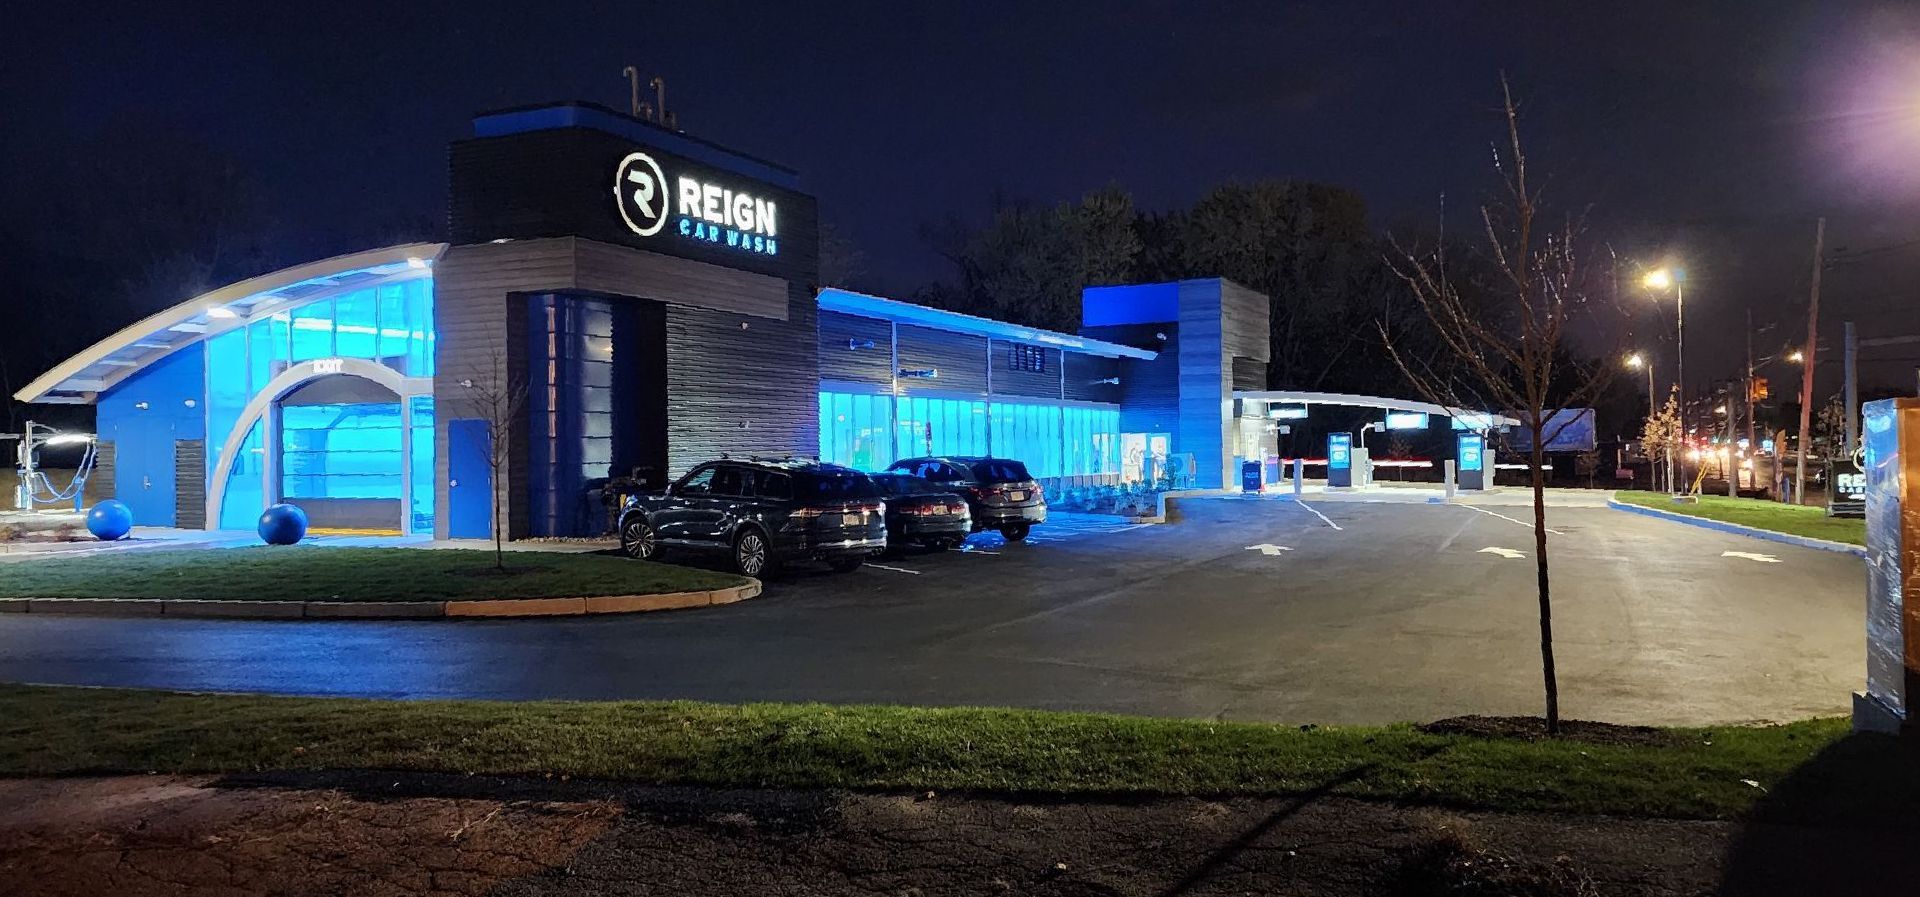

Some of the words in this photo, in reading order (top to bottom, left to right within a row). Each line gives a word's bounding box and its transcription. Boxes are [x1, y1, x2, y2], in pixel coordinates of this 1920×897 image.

[679, 176, 776, 236] REIGN
[679, 218, 719, 243] CAR
[726, 229, 776, 255] WASH
